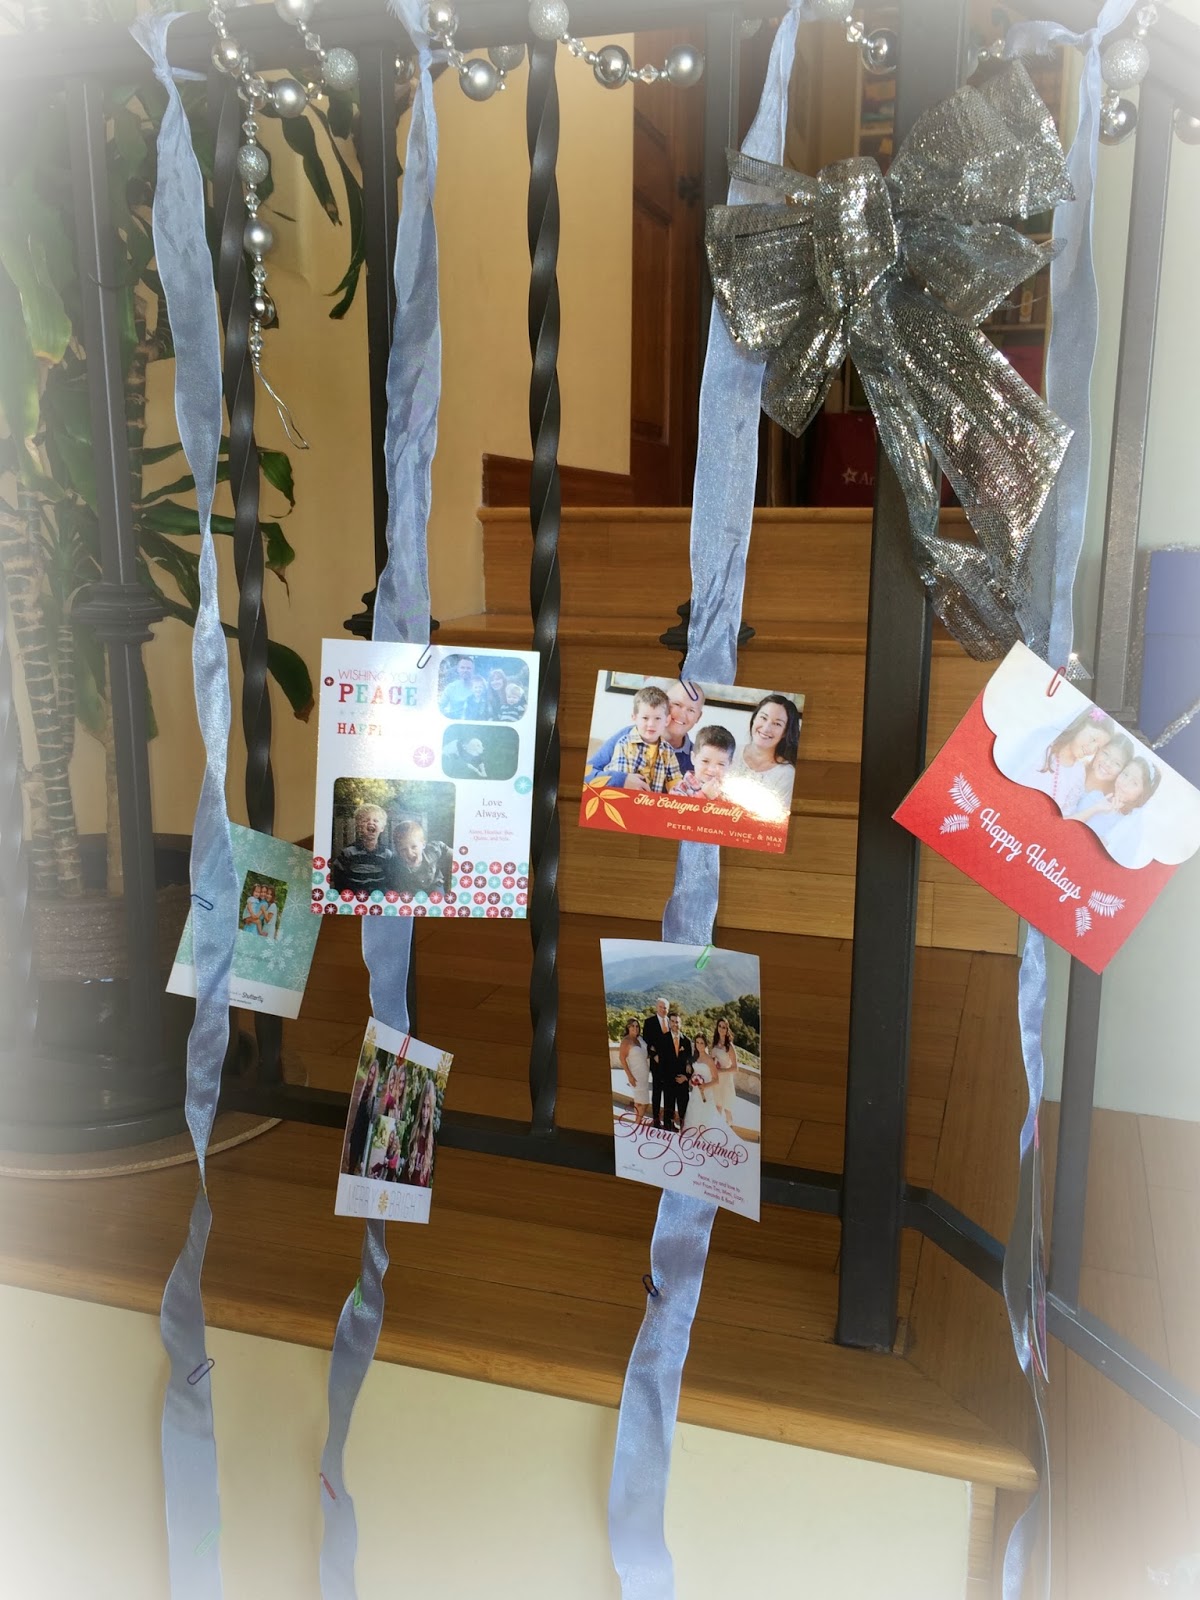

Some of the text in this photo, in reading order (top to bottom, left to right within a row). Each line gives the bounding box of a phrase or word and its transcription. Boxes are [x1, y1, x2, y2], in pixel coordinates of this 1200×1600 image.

[338, 669, 417, 684] WISHING YOU
[338, 683, 418, 707] PEACE
[482, 798, 503, 807] Love
[634, 793, 744, 823] The Cotugno Family
[475, 810, 508, 820] Always,
[666, 822, 783, 844] PETER, MEGAN, VINCE, & MAX
[980, 808, 1081, 903] Happy Holidays
[678, 1124, 749, 1168] Christmas
